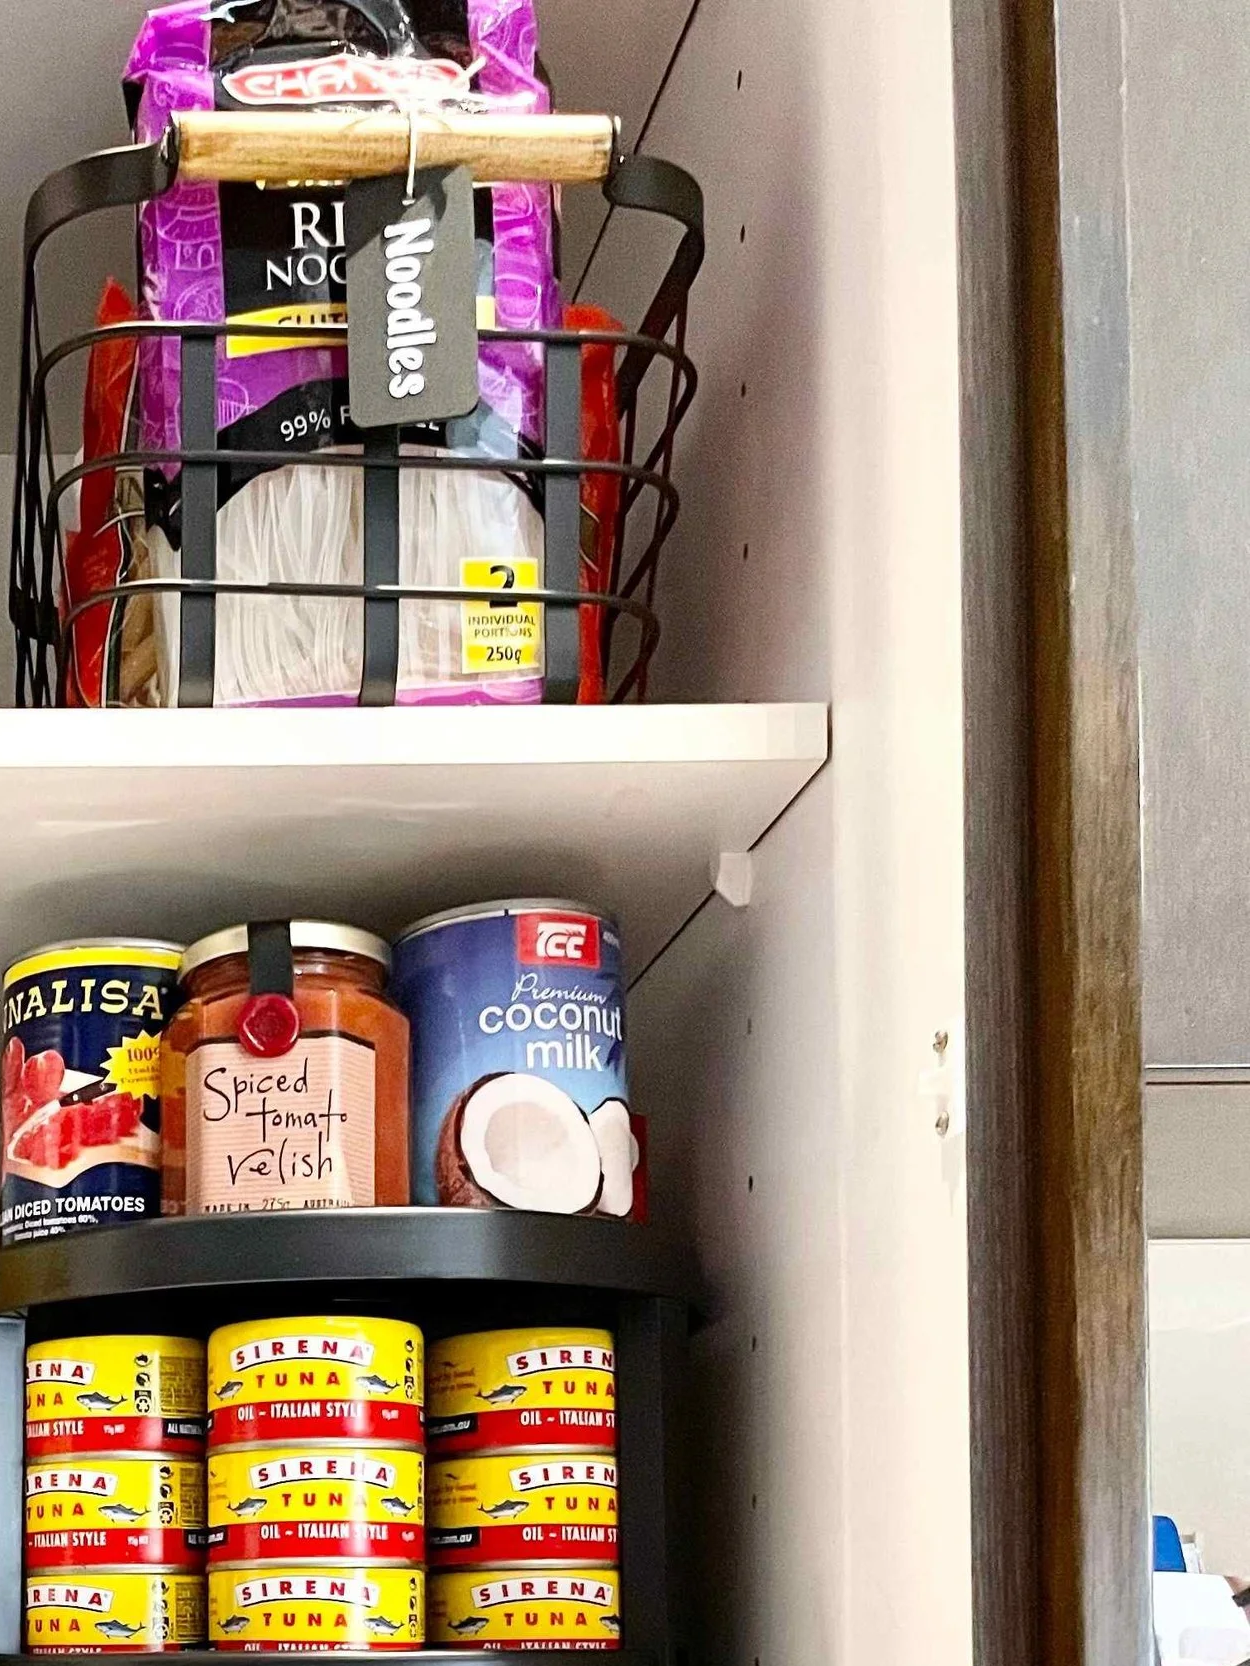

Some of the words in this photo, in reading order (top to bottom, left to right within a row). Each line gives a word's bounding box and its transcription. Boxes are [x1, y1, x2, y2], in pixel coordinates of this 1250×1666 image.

[290, 201, 346, 250] RI
[383, 217, 438, 399] Noodles
[280, 408, 331, 442] 99%
[489, 564, 519, 609] 2
[468, 614, 536, 625] INDIVIDUAL
[474, 627, 533, 638] PORTIONS
[486, 645, 522, 664] 250g
[511, 972, 607, 1003] Premium
[479, 1002, 623, 1041] coconut
[526, 1032, 603, 1072] milk
[203, 1057, 309, 1122] Spiced
[245, 1088, 348, 1143] tomato
[15, 1199, 52, 1222] DICED
[55, 1196, 146, 1214] TOMATOES
[235, 1339, 365, 1365] SIRENA
[516, 1349, 613, 1371] SIREN
[256, 1371, 341, 1388] TUNA
[542, 1380, 615, 1398] TUNA
[237, 1406, 255, 1421] OIL
[270, 1403, 321, 1419] ITALIAN
[520, 1410, 543, 1426] OIL
[559, 1409, 603, 1427] ITALIAN
[53, 1420, 85, 1437] STYLE
[518, 1465, 615, 1485] SIREN
[544, 1496, 616, 1511] TUNA
[34, 1533, 68, 1548] ITALIAN
[72, 1531, 107, 1547] STYLE
[260, 1523, 281, 1540] OIL
[298, 1522, 350, 1540] ITALIAN
[522, 1526, 544, 1541] OIL
[561, 1525, 605, 1542] ITALIAN
[33, 1588, 103, 1607] RENA
[479, 1580, 607, 1603] SIRENA
[263, 1612, 348, 1628] TUNA
[503, 1612, 588, 1627] TUNA
